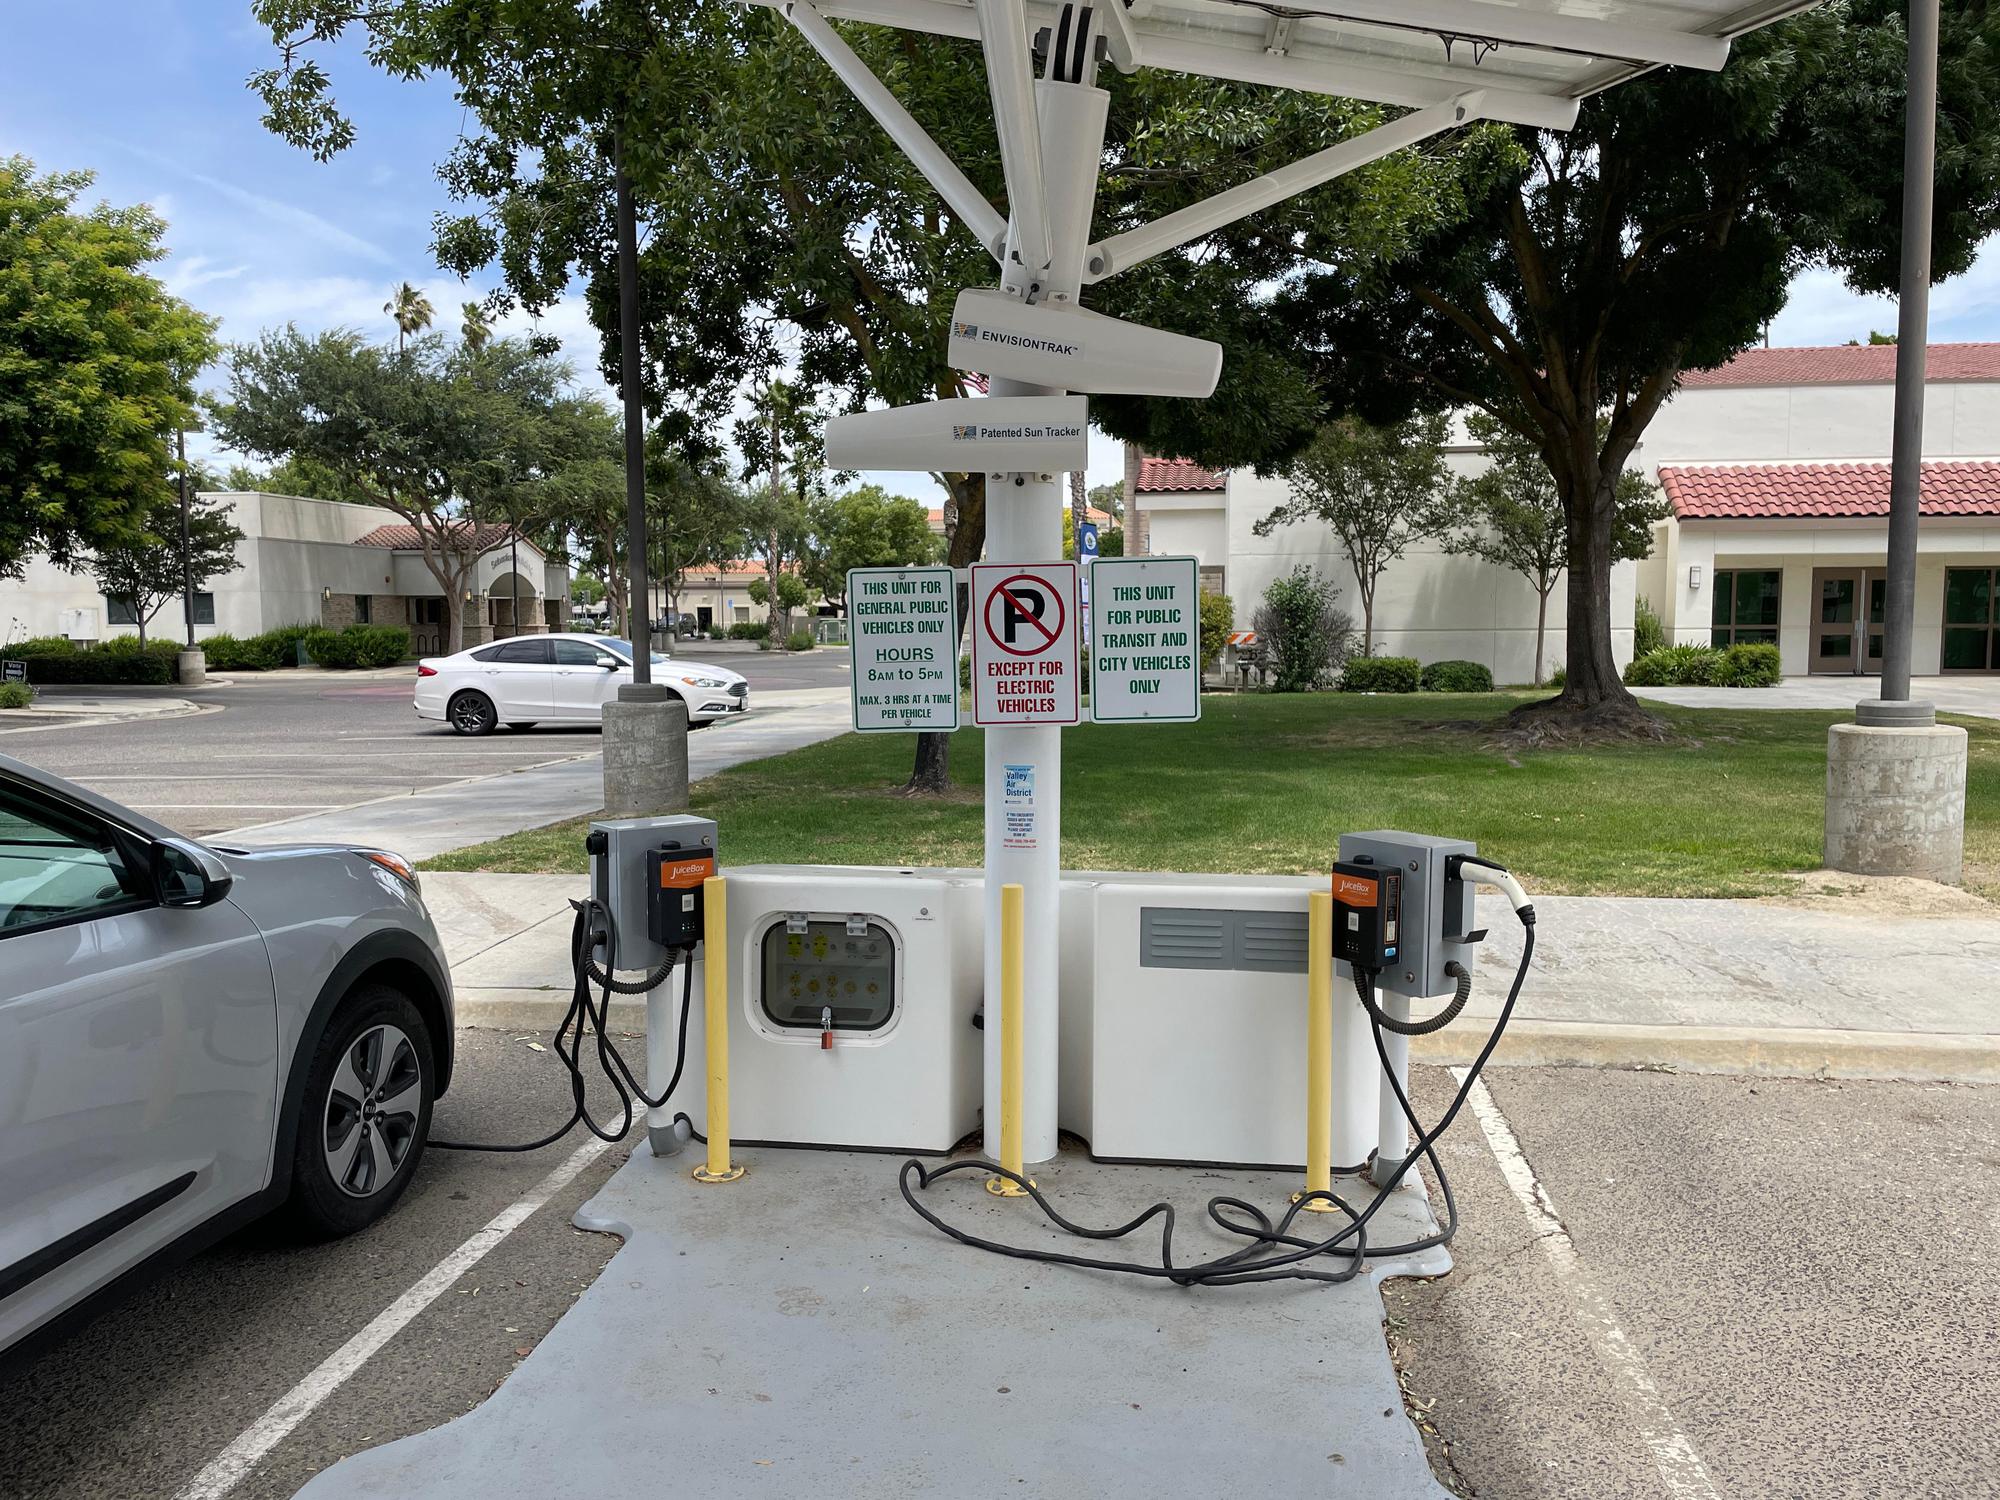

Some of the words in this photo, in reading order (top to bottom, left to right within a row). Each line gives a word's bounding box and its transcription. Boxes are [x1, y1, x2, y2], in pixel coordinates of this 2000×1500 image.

[981, 428, 1022, 438] Patented
[1024, 428, 1043, 437] Sun
[1045, 427, 1080, 437] Tracker
[862, 582, 888, 595] THIS
[891, 581, 917, 594] UNIT
[920, 581, 942, 594] FOR
[1112, 587, 1141, 601] THIS
[1145, 586, 1175, 600] UNIT
[857, 601, 906, 615] GENERAL
[909, 600, 948, 614] PUBLIC
[1107, 610, 1131, 624] FOR
[1135, 609, 1181, 624] PUBLIC
[862, 621, 914, 634] VEHICLES
[917, 620, 944, 633] ONLY
[1102, 633, 1156, 648] TRANSIT
[1161, 632, 1188, 646] AND
[876, 647, 934, 661] HOURS
[988, 662, 1035, 676] EXCEPT
[1039, 661, 1063, 675] FOR
[1099, 657, 1127, 671] CITY
[1132, 655, 1191, 671] VEHICLES
[868, 668, 894, 681] 8AM
[898, 668, 914, 680] to
[918, 667, 943, 680] 5PM
[997, 680, 1054, 695] ELECTRIC
[1129, 679, 1160, 694] ONLY
[860, 695, 882, 705] MAX.
[884, 695, 890, 705] 3
[892, 695, 910, 704] HRS
[912, 695, 921, 704] AT
[924, 694, 930, 703] A
[932, 694, 952, 703] TIME
[997, 698, 1055, 713] VEHICLES
[881, 709, 897, 719] PER
[900, 709, 932, 718] VEHICLE
[1006, 771, 1028, 781] Valley
[1006, 780, 1016, 788] Air
[1006, 788, 1032, 797] District
[670, 864, 705, 879] JuiceBox
[1339, 880, 1369, 892] JuiceBox
